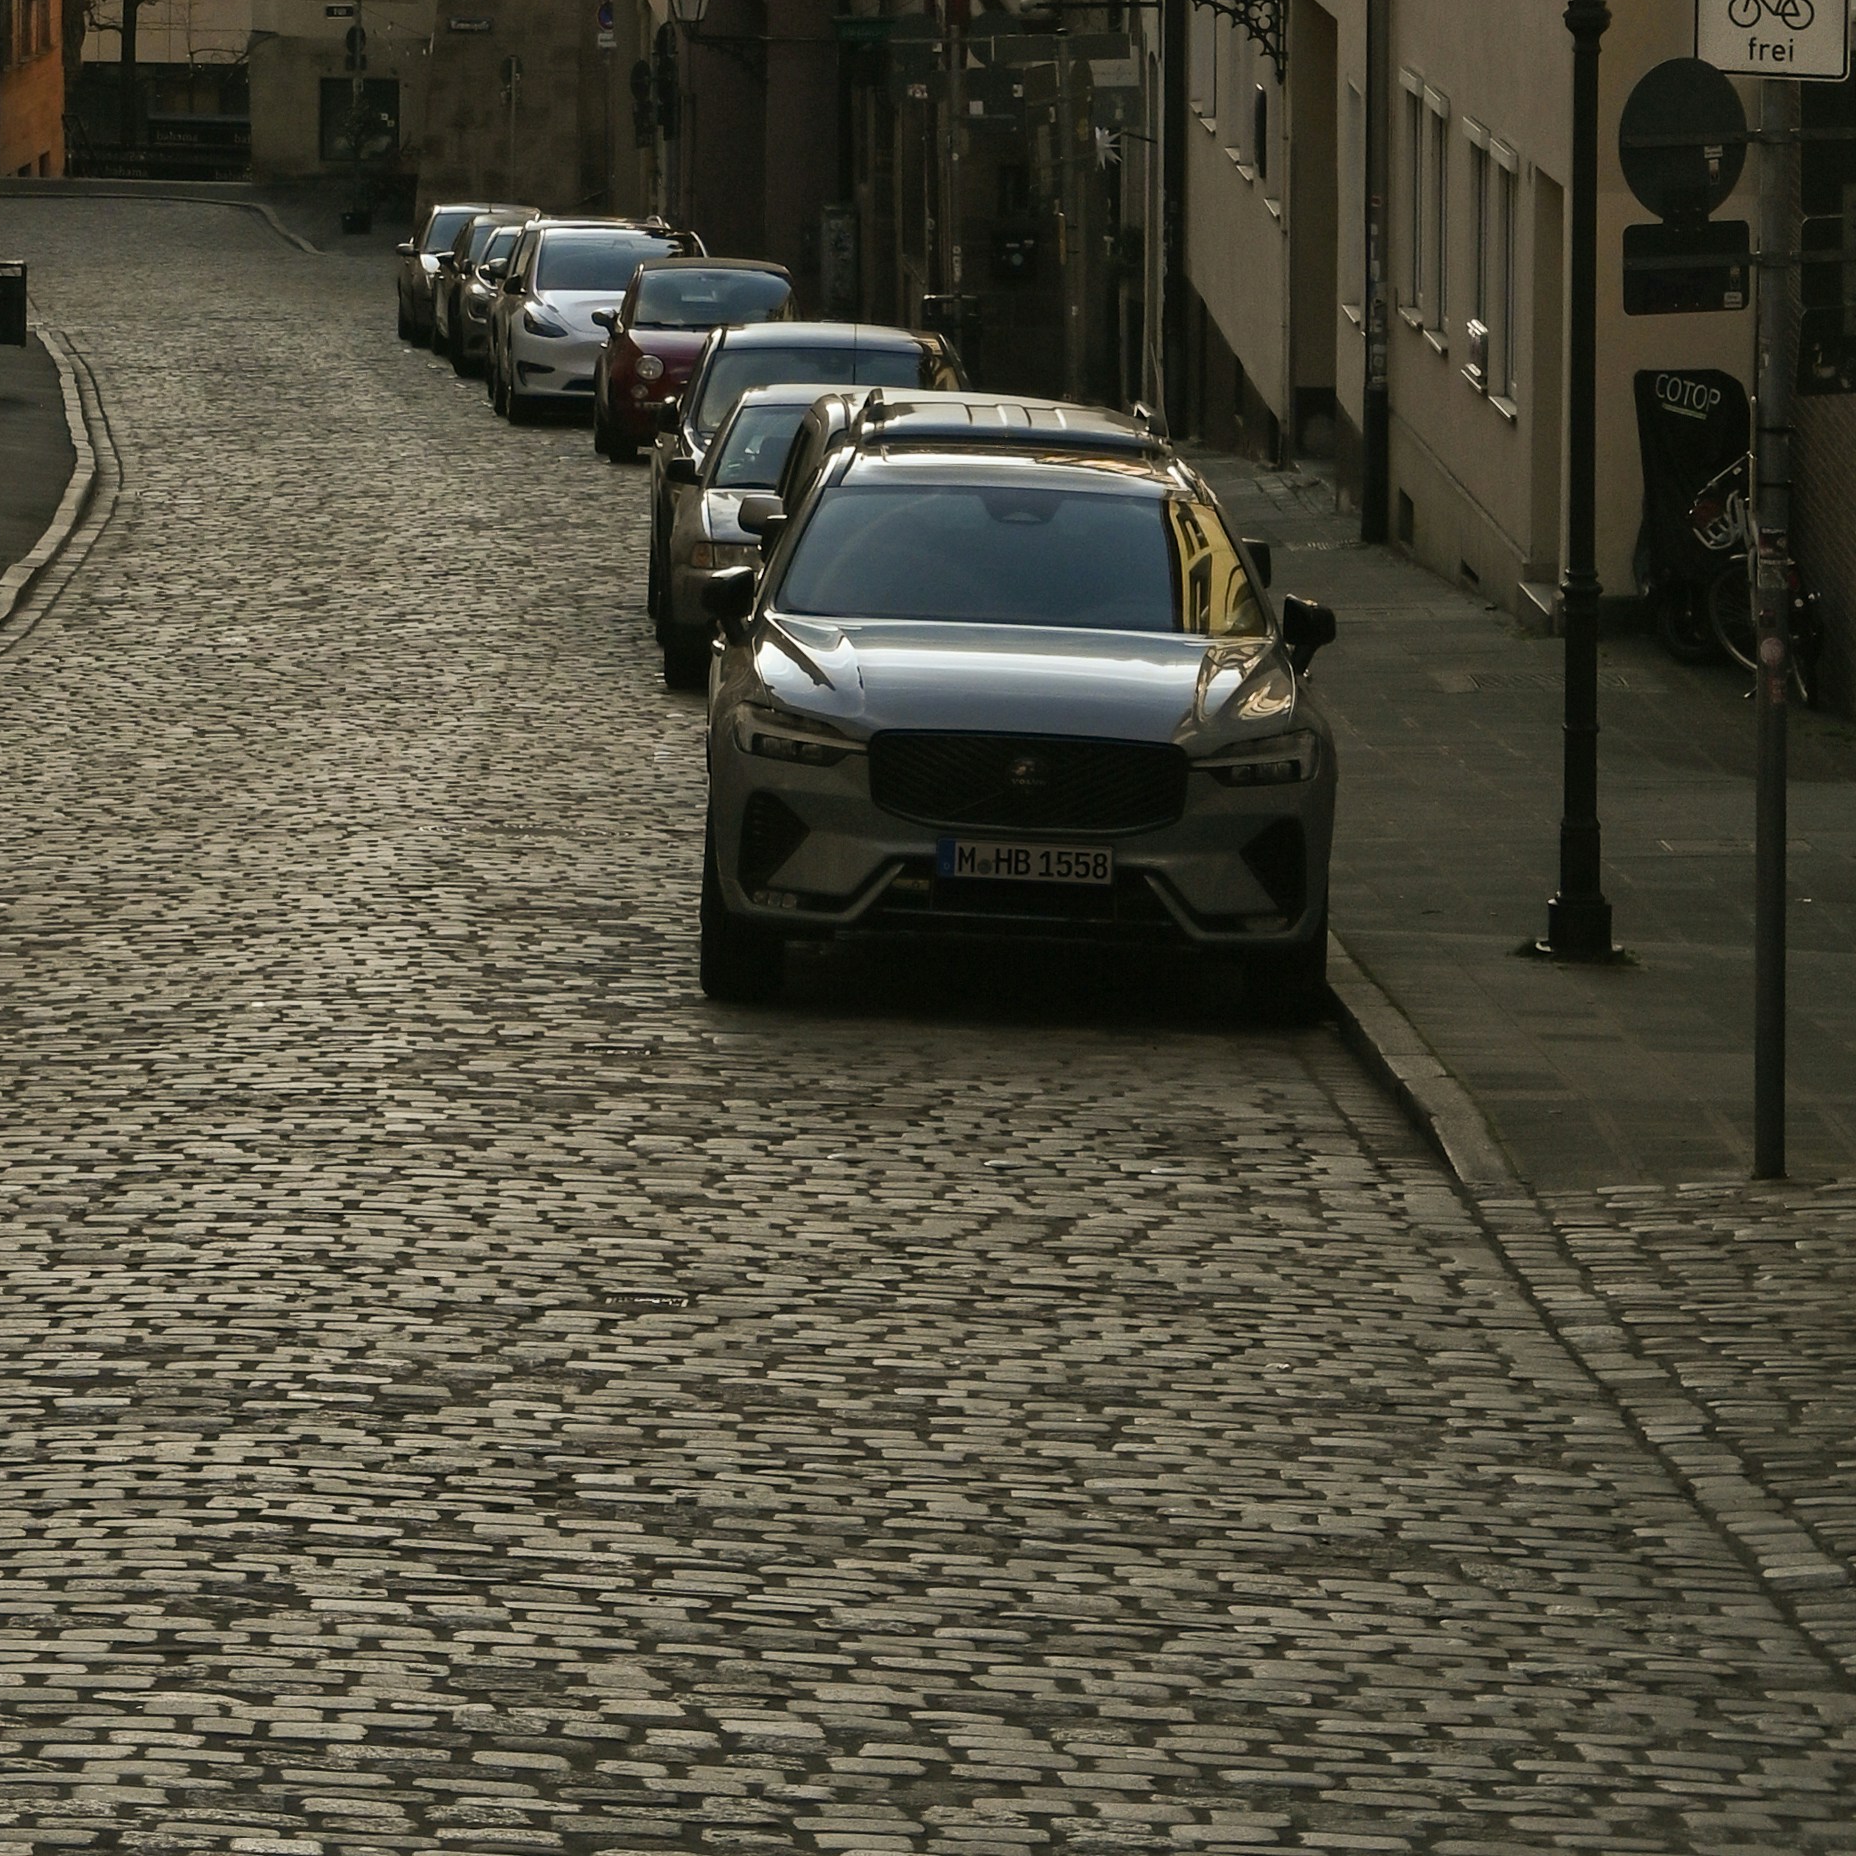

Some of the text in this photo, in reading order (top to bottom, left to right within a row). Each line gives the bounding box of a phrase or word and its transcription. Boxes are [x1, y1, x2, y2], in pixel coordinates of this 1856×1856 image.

[1748, 37, 1794, 62] frei
[1655, 374, 1721, 412] COTOP
[958, 847, 1107, 880] M HB 1558
